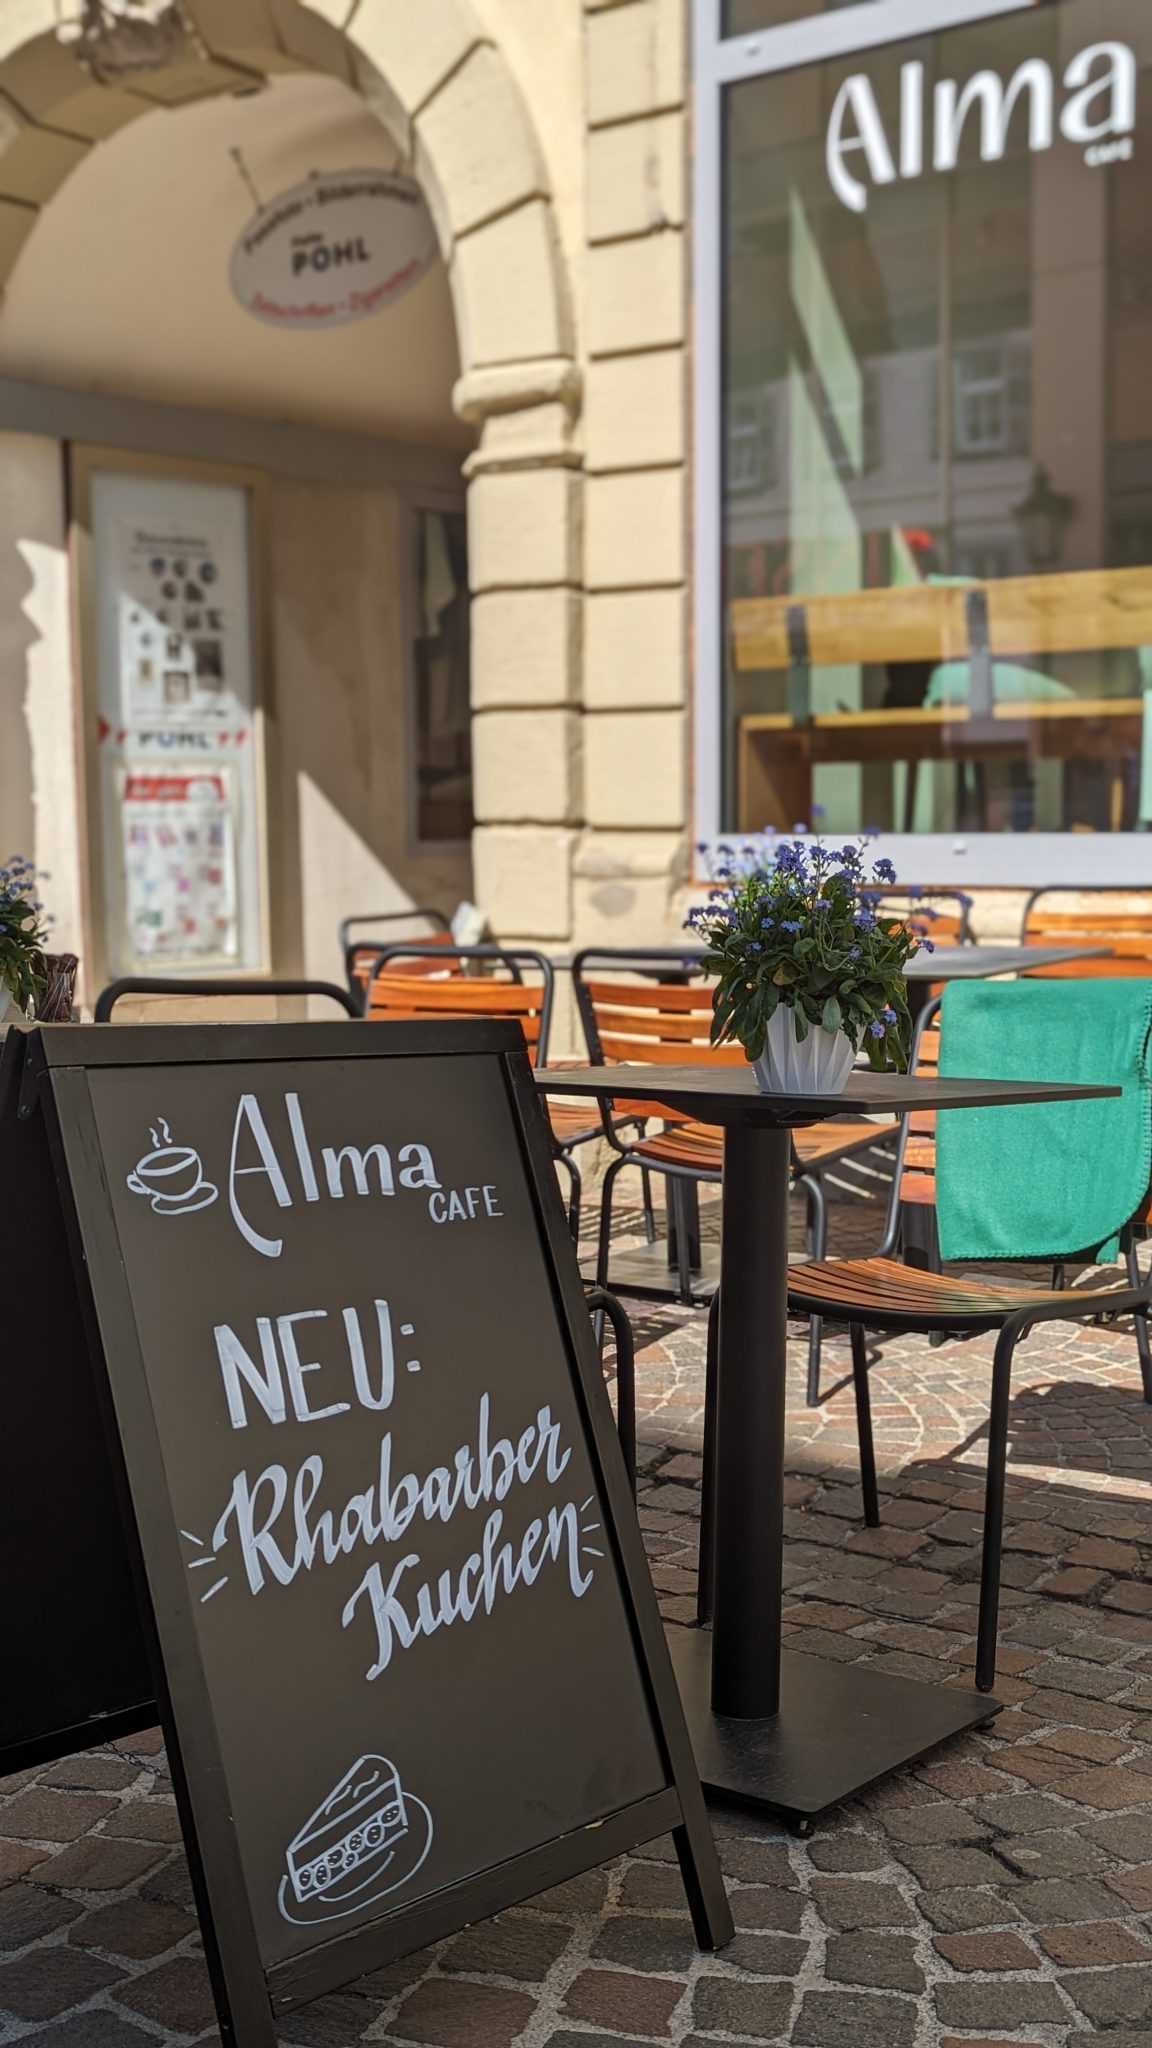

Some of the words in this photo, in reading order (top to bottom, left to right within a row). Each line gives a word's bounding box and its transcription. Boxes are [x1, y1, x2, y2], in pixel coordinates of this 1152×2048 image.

[826, 41, 1136, 211] Alma
[229, 1094, 443, 1258] Alma
[428, 1185, 504, 1224] CAFE
[213, 1299, 421, 1429] NEU:
[212, 1391, 572, 1596] Rhabarber
[342, 1502, 594, 1681] Kuchen
